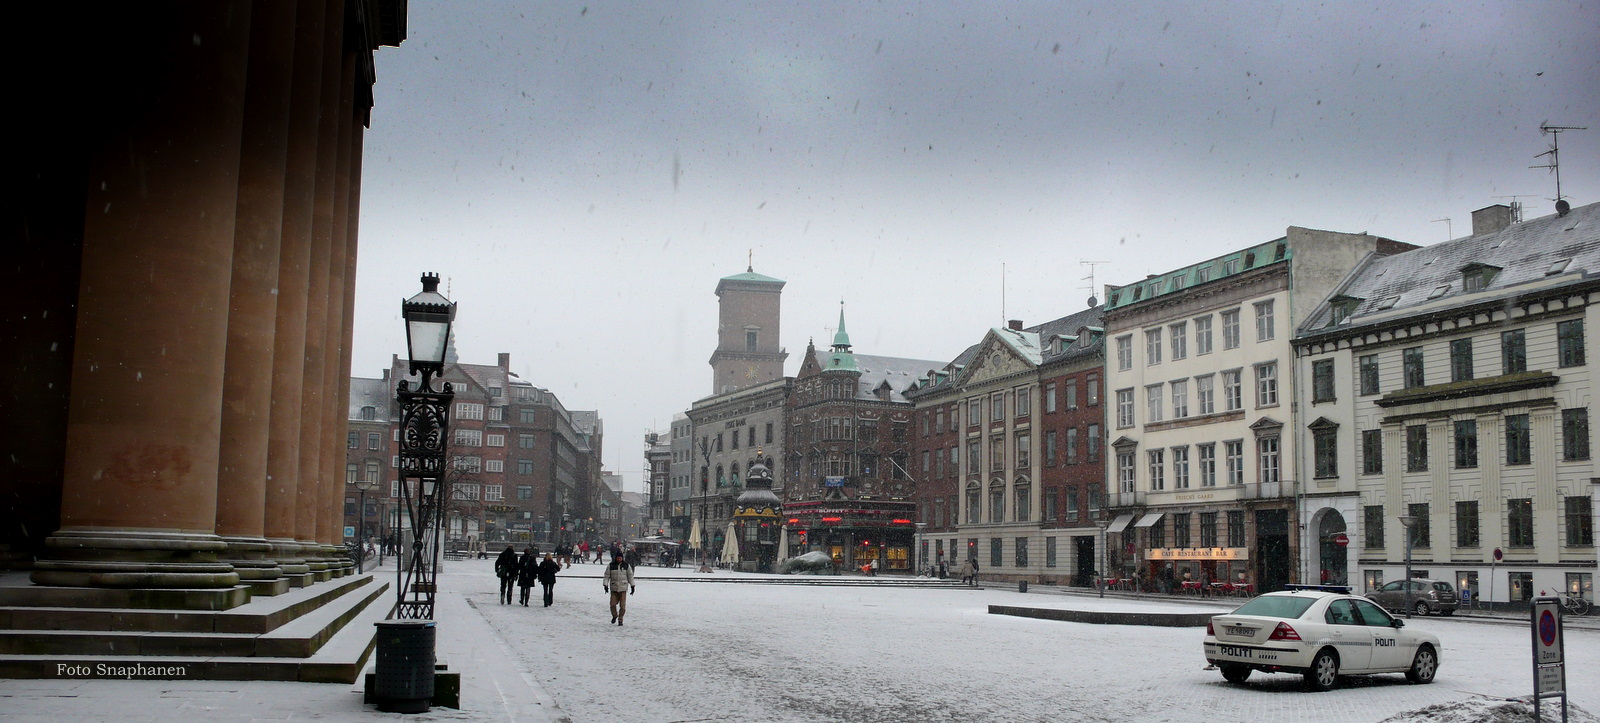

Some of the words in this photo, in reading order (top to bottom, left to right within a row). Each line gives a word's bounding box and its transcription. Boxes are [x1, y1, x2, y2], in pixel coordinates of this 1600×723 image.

[1375, 638, 1396, 647] POLITI
[1220, 646, 1252, 658] POLITI
[1542, 651, 1556, 660] Zone
